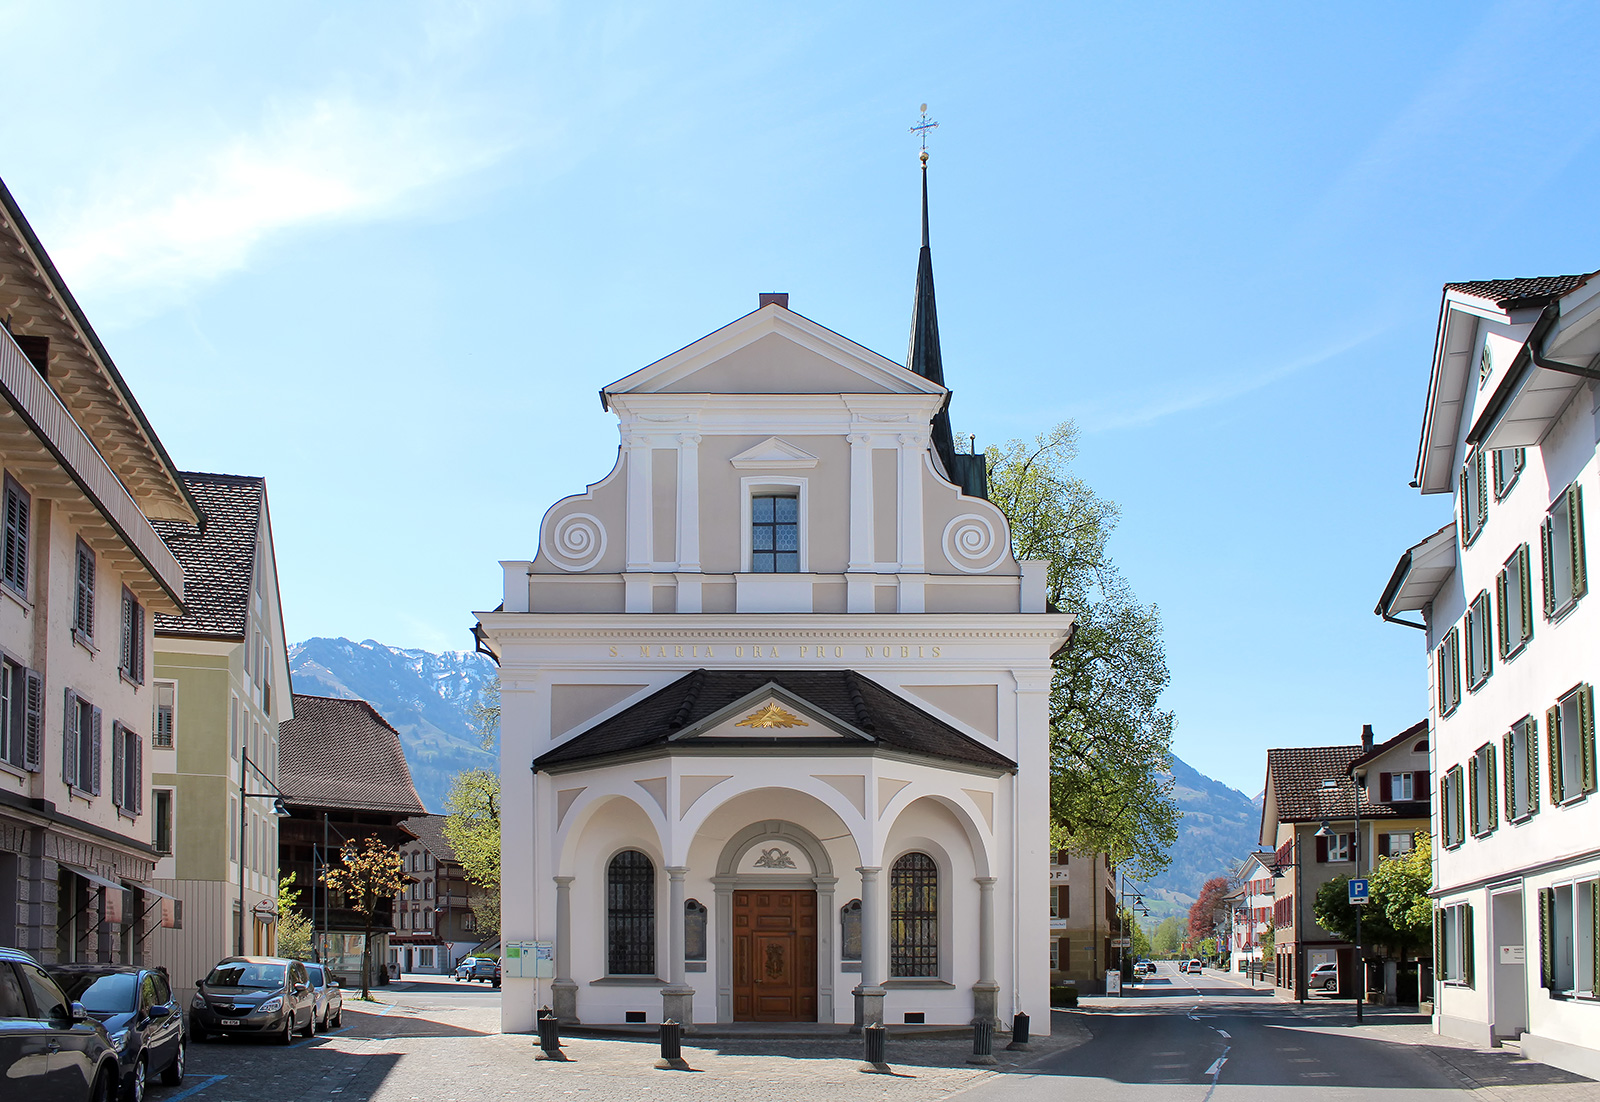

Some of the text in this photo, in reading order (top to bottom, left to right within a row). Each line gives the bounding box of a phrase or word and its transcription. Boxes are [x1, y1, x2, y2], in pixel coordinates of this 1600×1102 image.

[640, 645, 714, 658] MARIA
[735, 645, 779, 658] ORA
[799, 645, 844, 658] PRO
[865, 645, 941, 658] NOBIS
[1355, 882, 1364, 895] P
